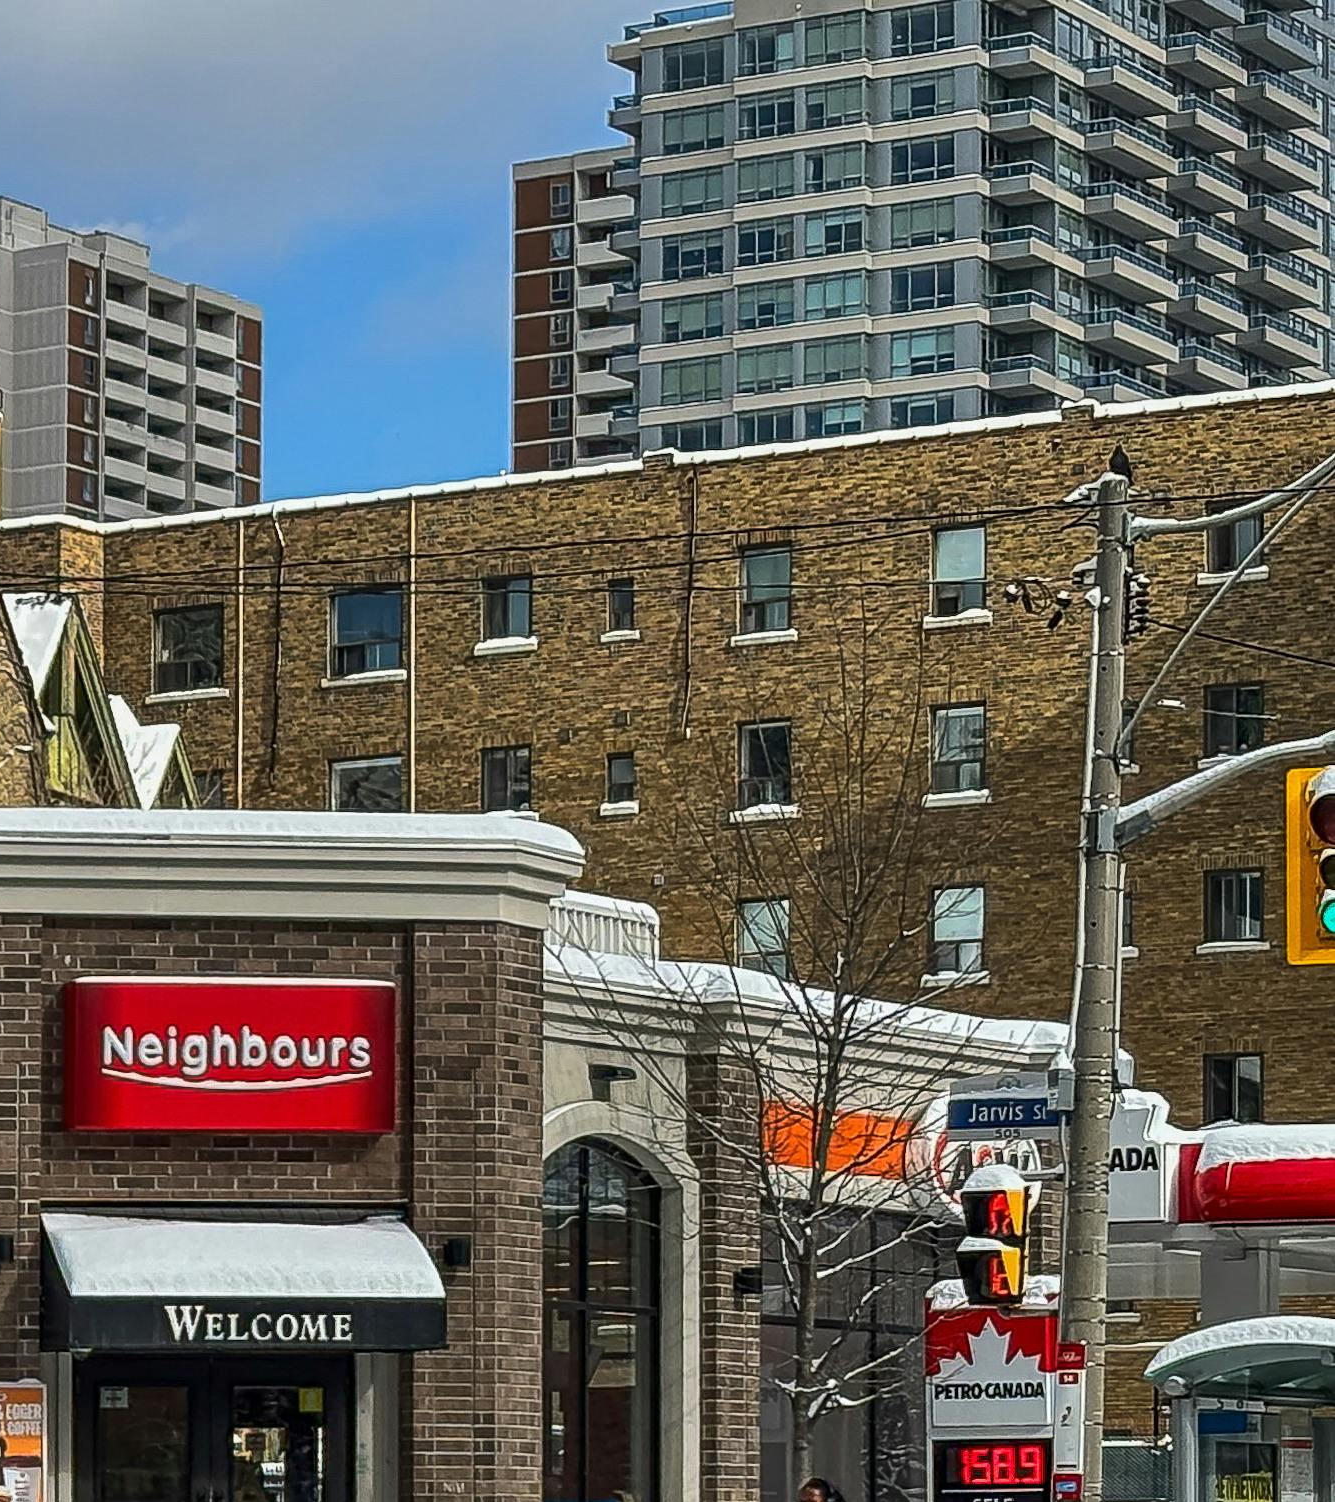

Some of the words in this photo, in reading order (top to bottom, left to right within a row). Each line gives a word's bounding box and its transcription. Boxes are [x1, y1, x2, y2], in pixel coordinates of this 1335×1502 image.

[101, 1025, 372, 1076] Neighbours
[968, 1101, 1023, 1123] Jarvis
[995, 1129, 1021, 1139] 505
[164, 1304, 354, 1342] WELCOME
